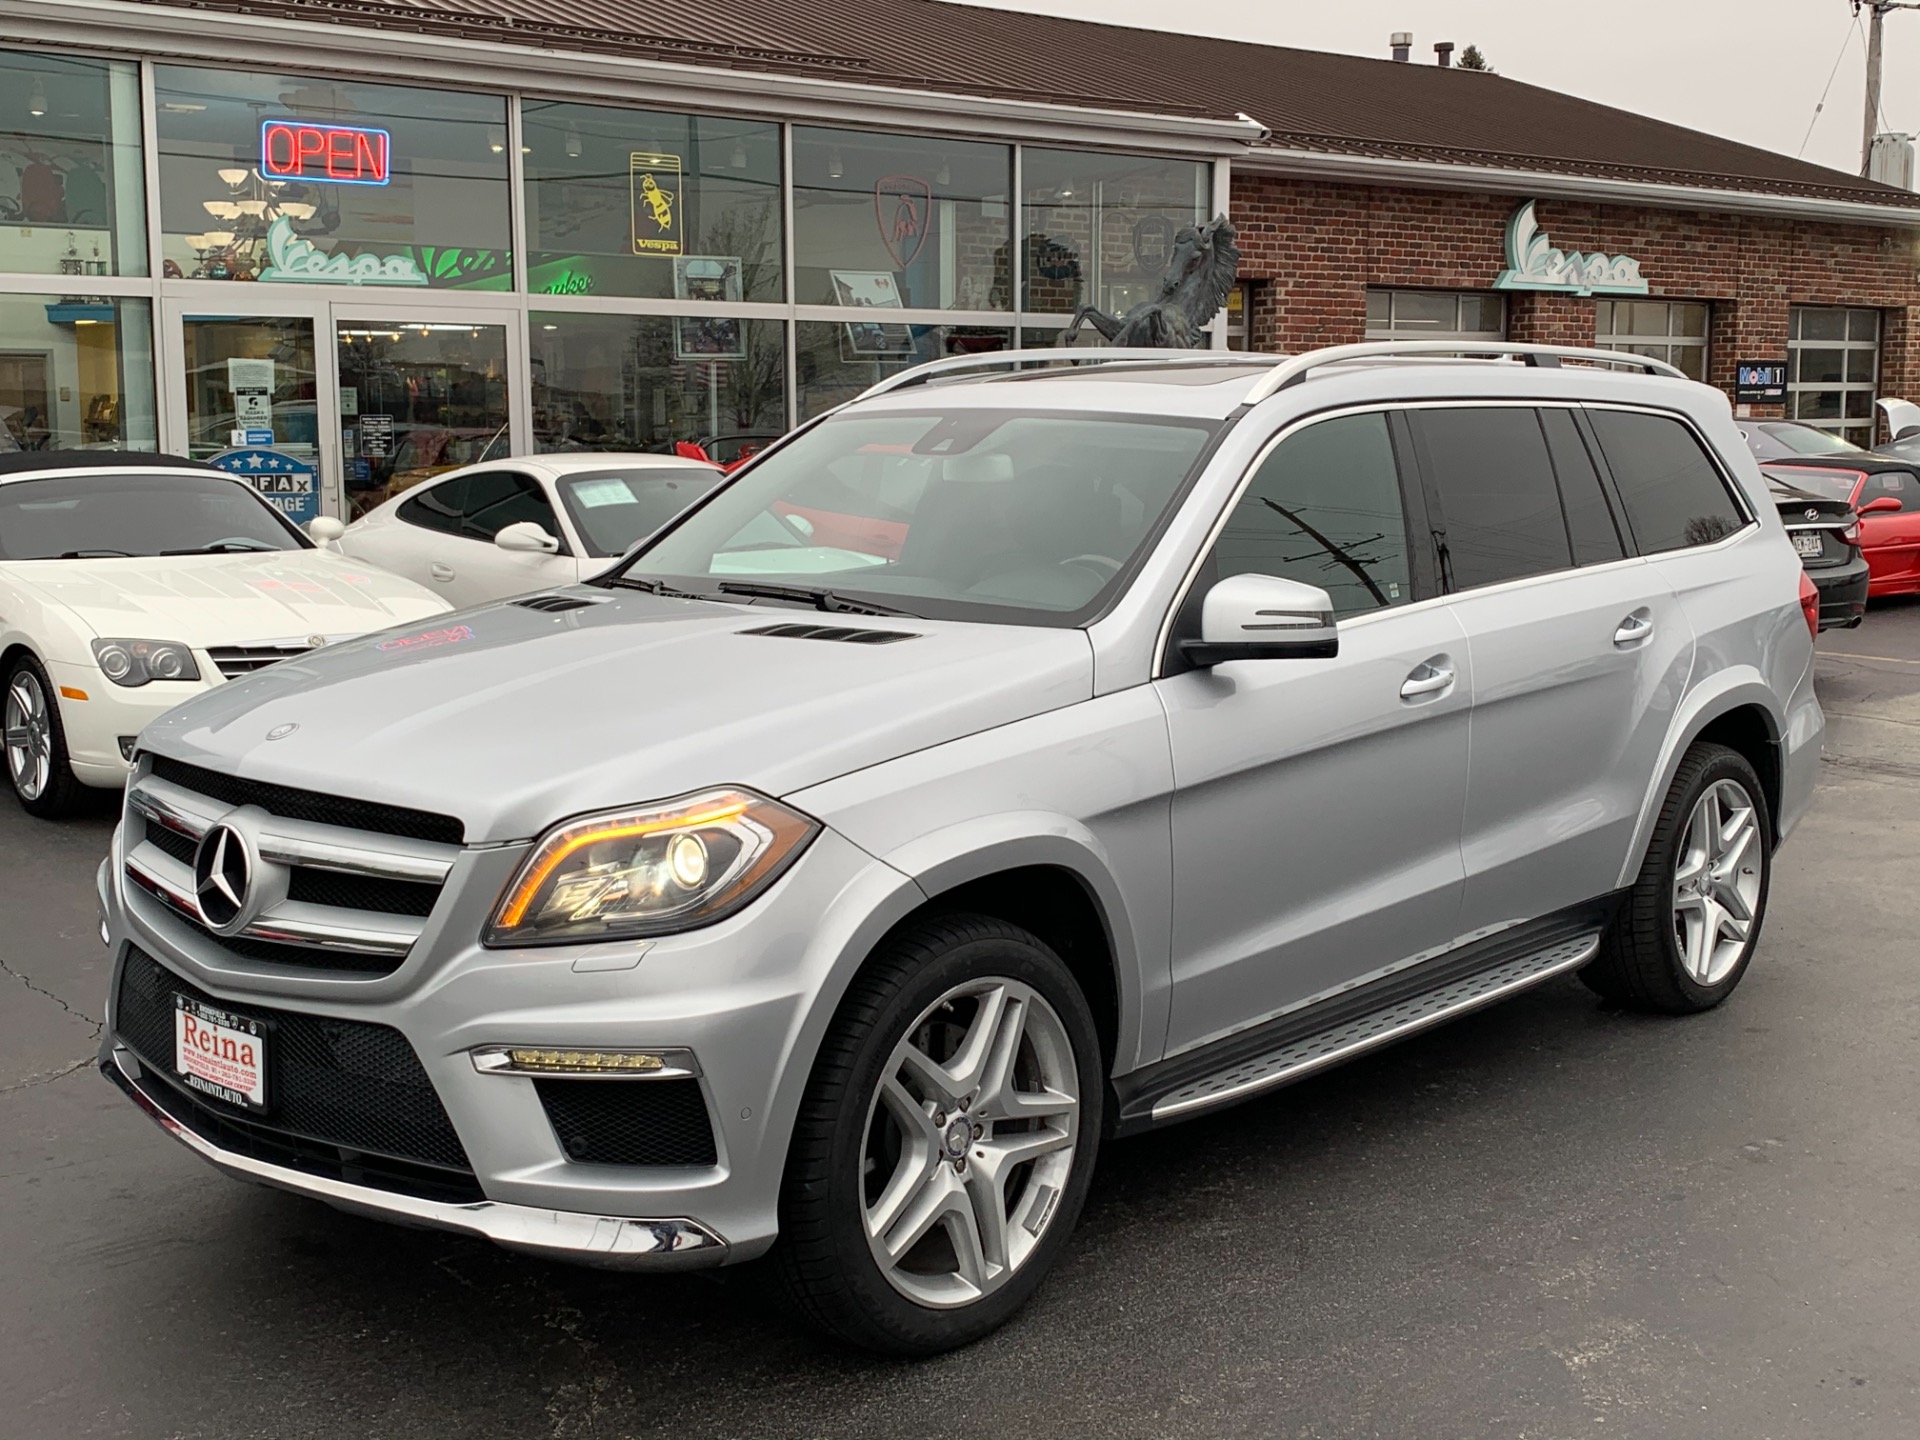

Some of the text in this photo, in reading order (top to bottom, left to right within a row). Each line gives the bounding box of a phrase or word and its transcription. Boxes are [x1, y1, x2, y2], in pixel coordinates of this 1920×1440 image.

[267, 126, 385, 180] OPEN
[264, 215, 426, 284] Vespa
[637, 239, 679, 251] Vespa
[1509, 202, 1645, 292] Vespa
[1739, 366, 1772, 385] Mobil
[242, 477, 308, 492] RFAX
[183, 1013, 256, 1068] Reina
